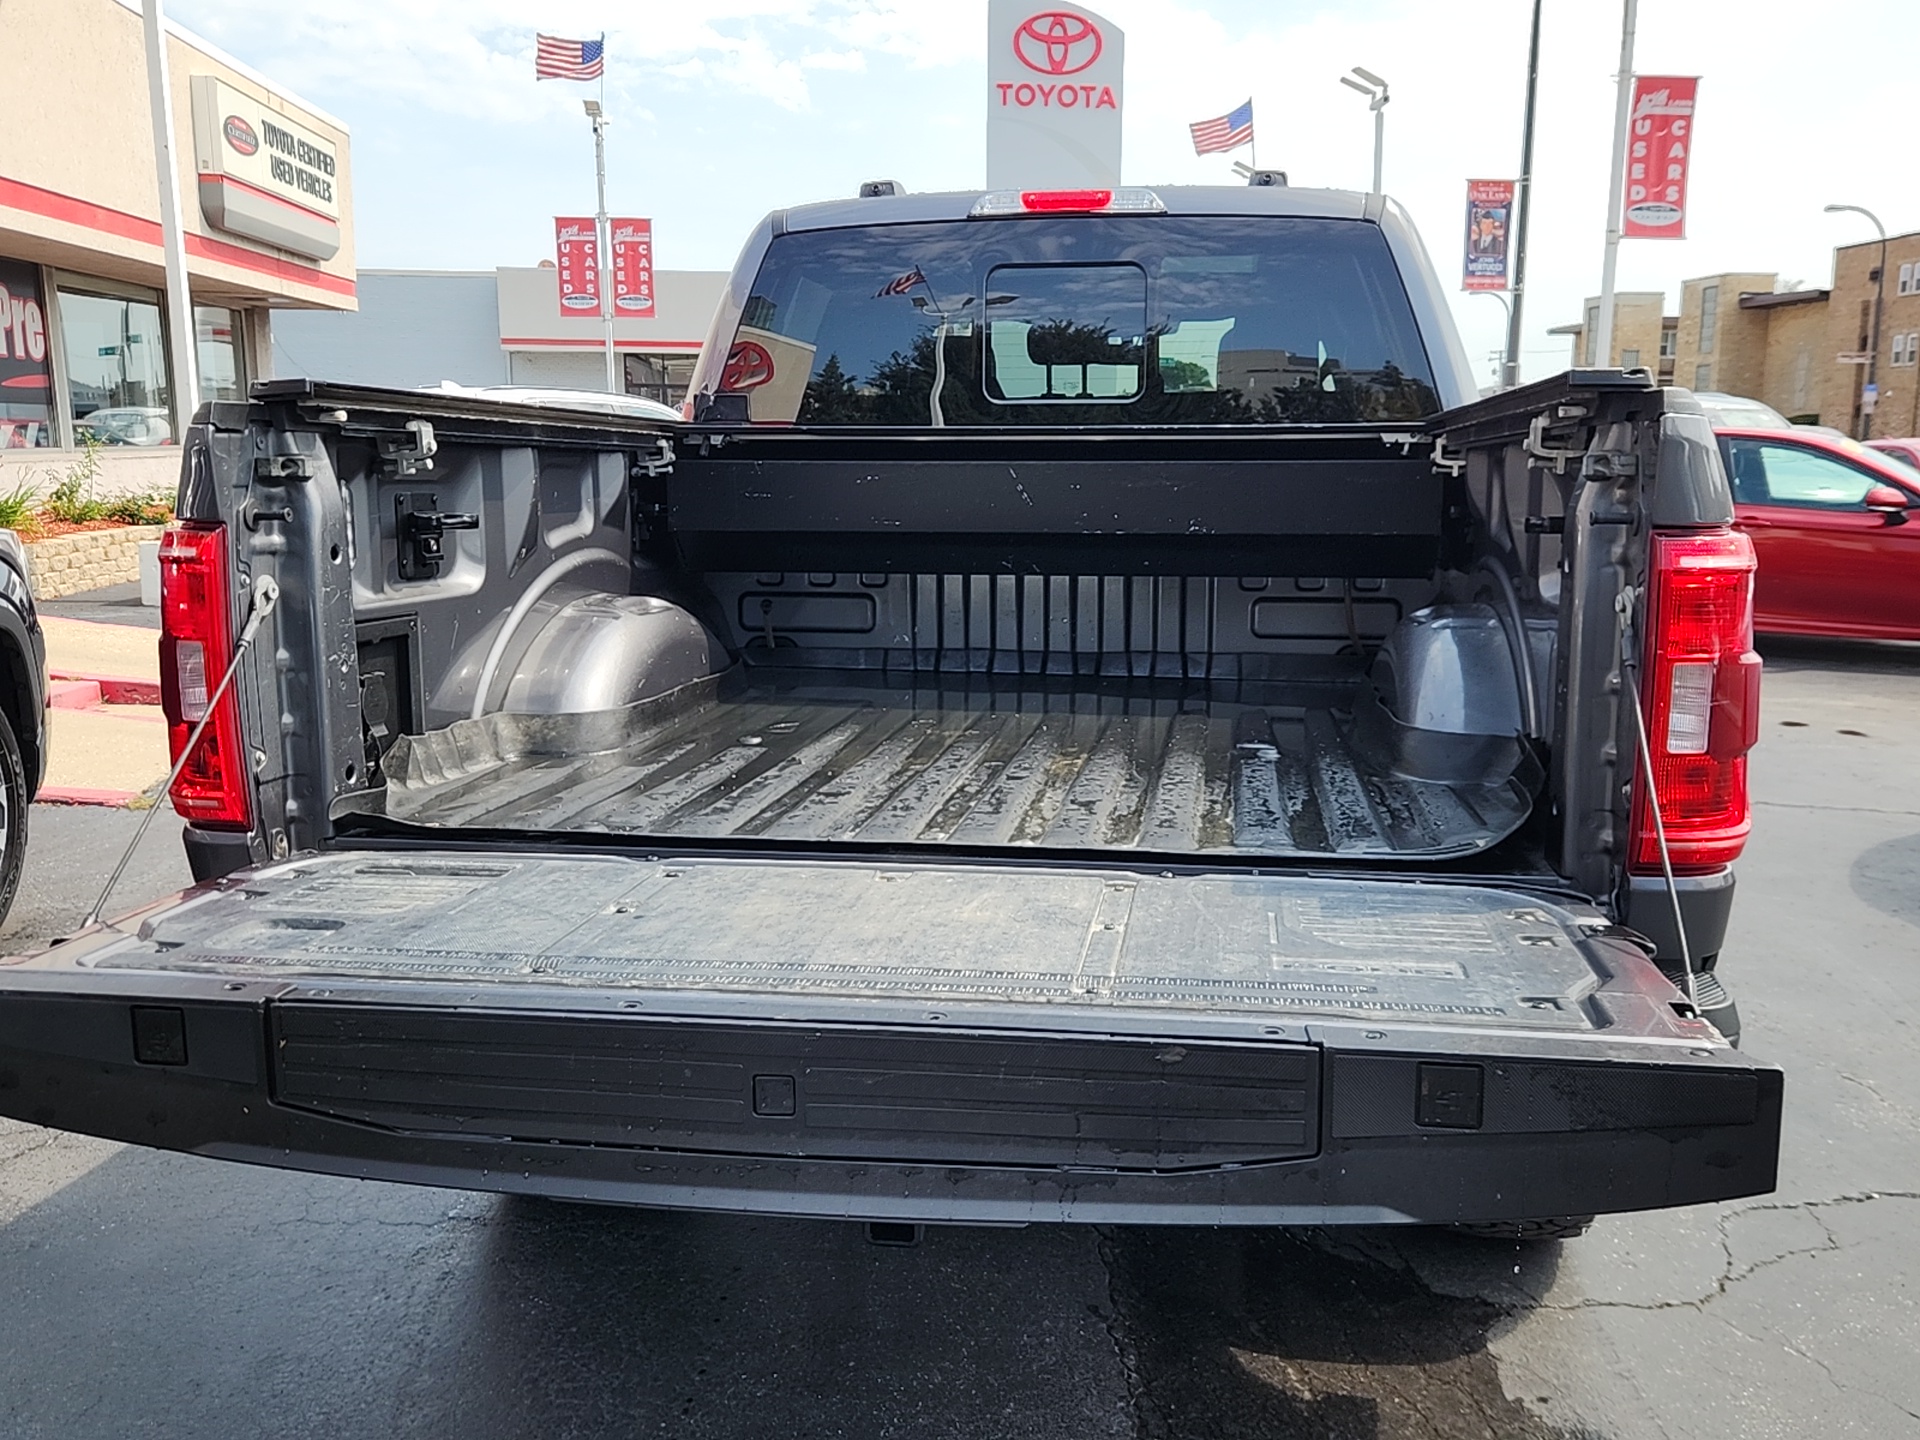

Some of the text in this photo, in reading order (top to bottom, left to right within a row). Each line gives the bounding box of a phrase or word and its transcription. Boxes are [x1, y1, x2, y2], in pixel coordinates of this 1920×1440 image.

[996, 83, 1117, 109] TOYOTA
[261, 119, 297, 159] TOYOTA
[297, 137, 336, 178] CERTIFIED
[1630, 118, 1651, 200] USED
[1665, 119, 1687, 202] CARS
[270, 154, 333, 203] USED VEHICLES
[561, 243, 573, 293] USED
[584, 243, 596, 294] CARS
[615, 244, 627, 294] USED
[638, 244, 650, 295] CARS
